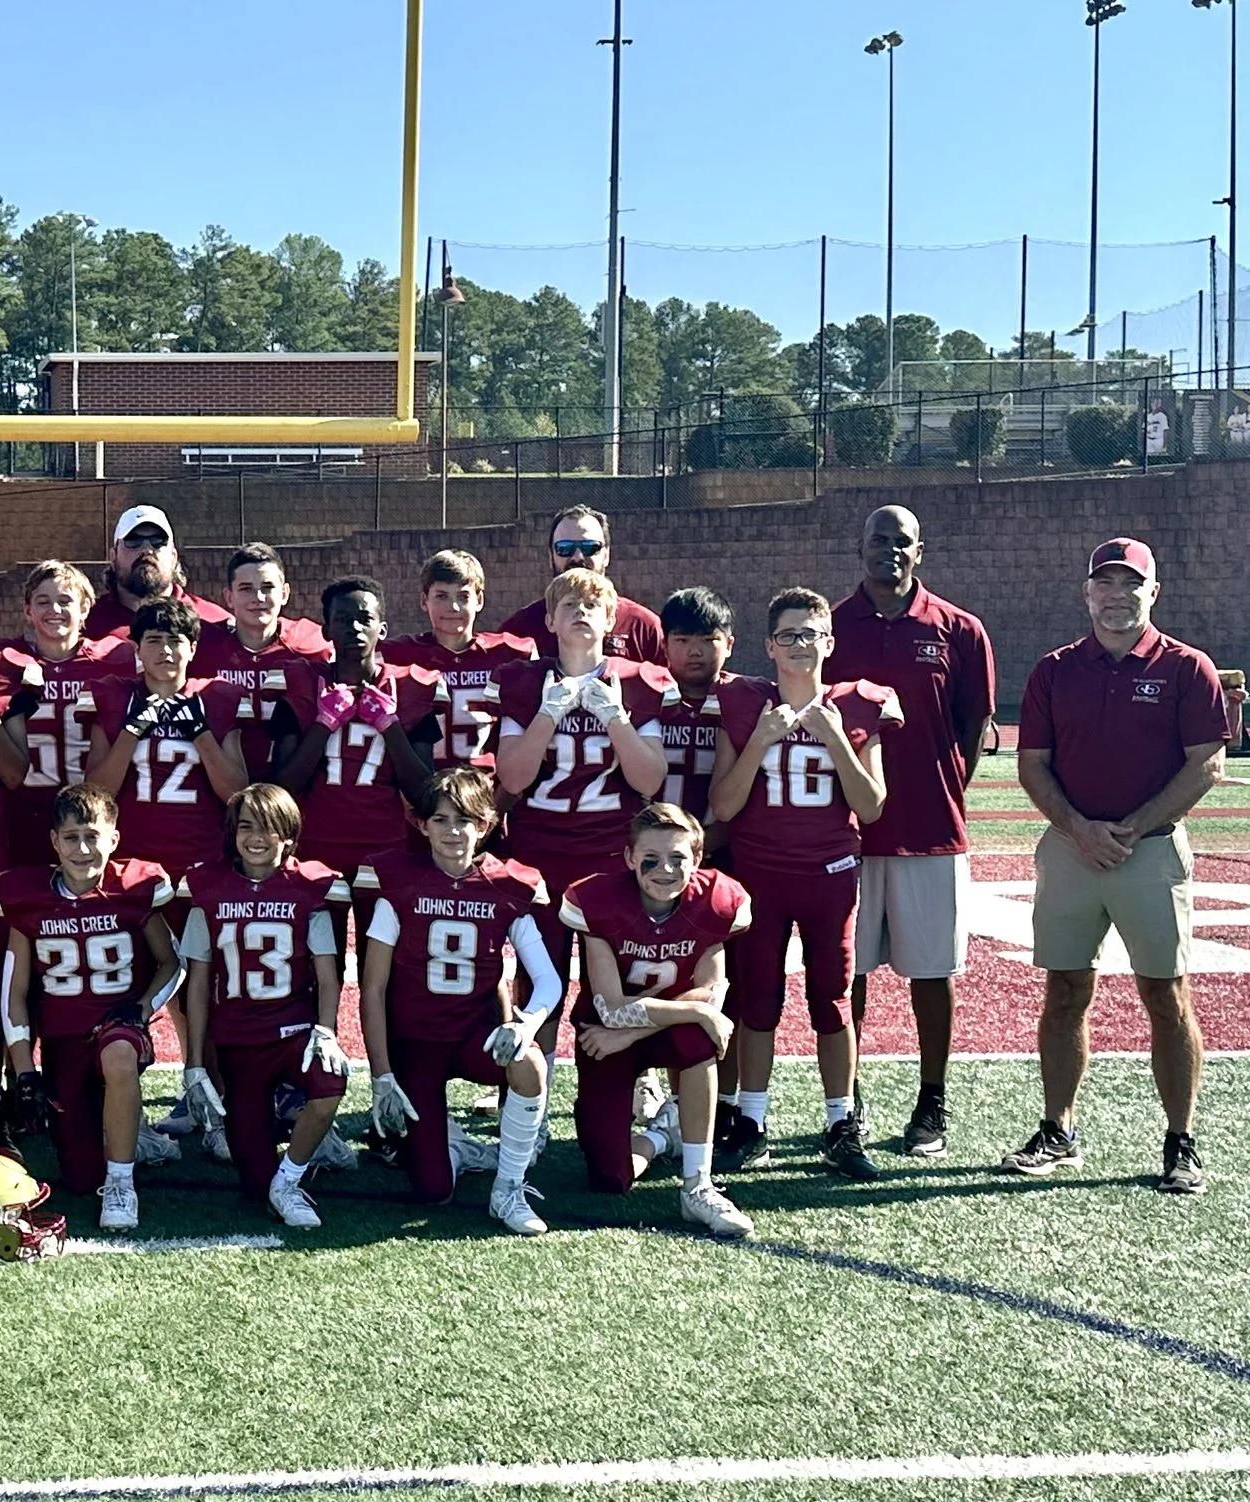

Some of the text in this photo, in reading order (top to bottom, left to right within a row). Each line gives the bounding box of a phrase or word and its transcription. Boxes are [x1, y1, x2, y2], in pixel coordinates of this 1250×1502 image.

[132, 739, 200, 805] 12
[326, 721, 385, 786] 17
[527, 733, 622, 813] 22
[761, 743, 836, 807] 16
[39, 914, 119, 935] JOHNS CREEK
[215, 902, 296, 920] JOHNS CREEK
[414, 897, 496, 919] JOHNS CREEK
[216, 922, 294, 1000] 13
[426, 919, 479, 995] 8
[618, 940, 696, 959] JOHNS CREEK
